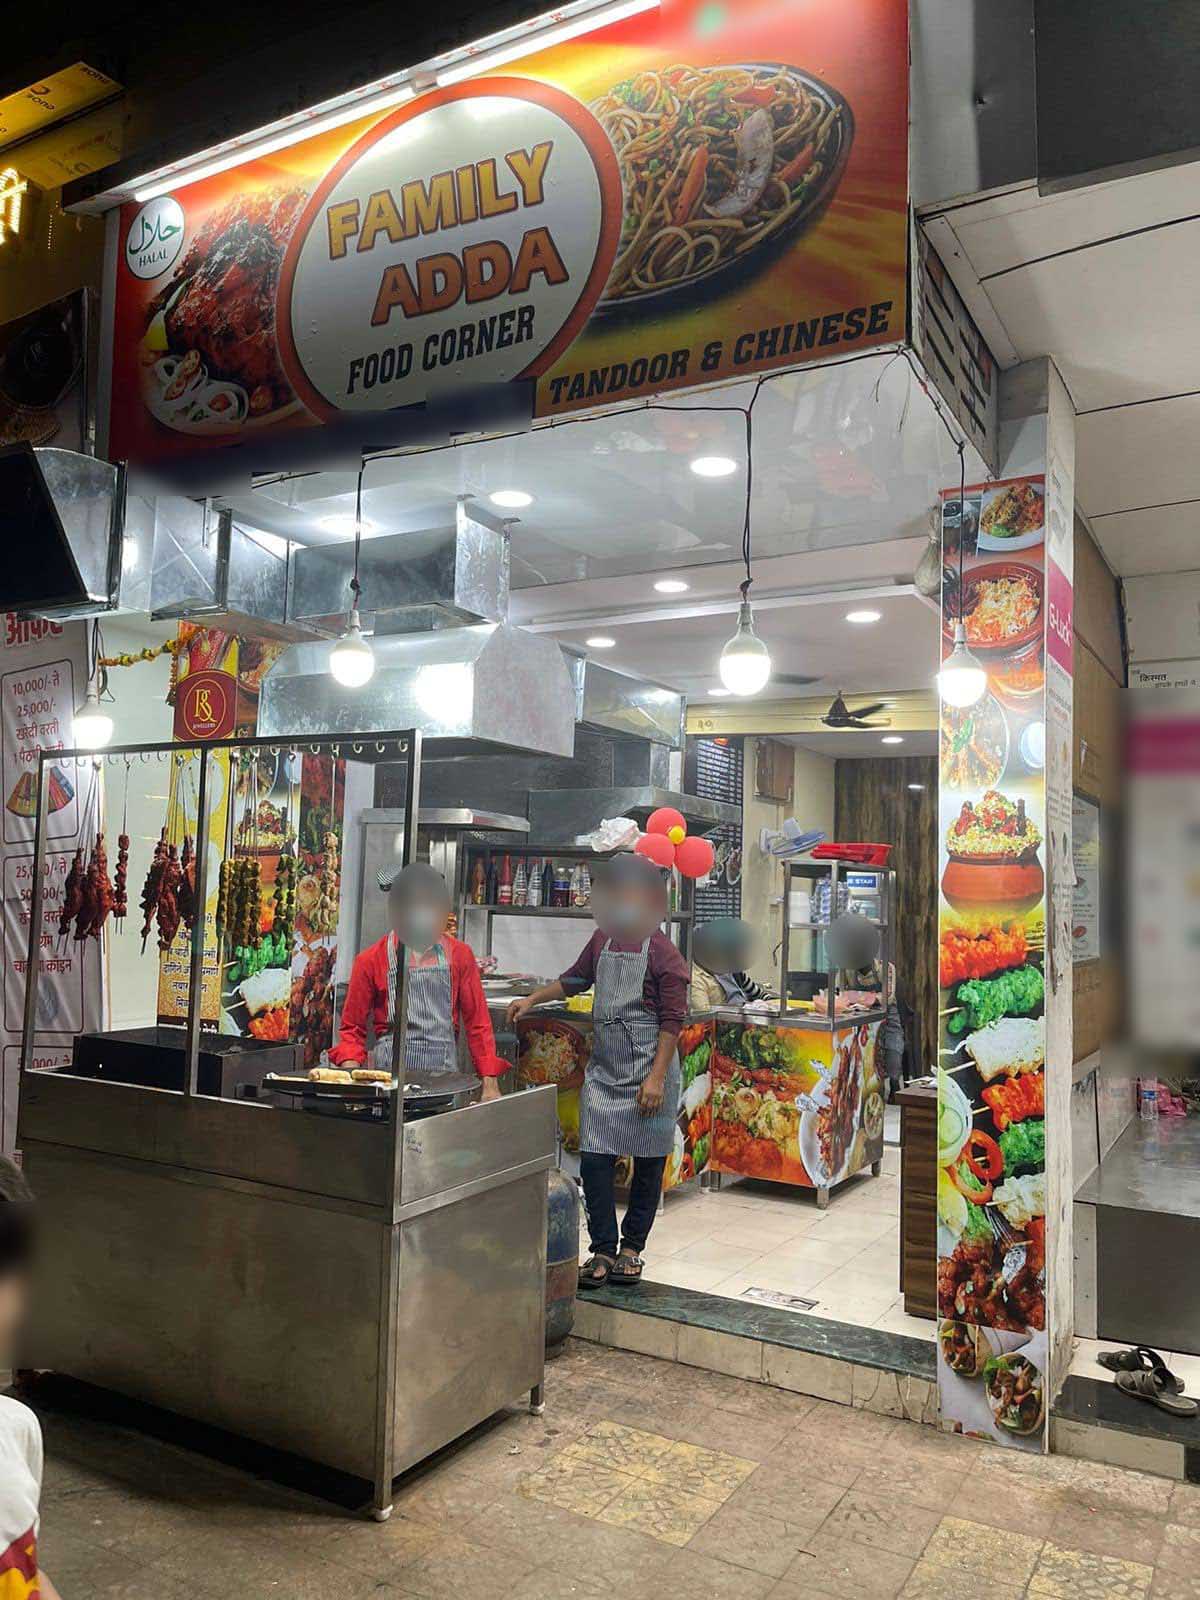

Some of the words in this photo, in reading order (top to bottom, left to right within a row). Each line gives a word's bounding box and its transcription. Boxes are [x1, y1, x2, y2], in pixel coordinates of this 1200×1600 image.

[129, 214, 181, 255] حلال
[327, 140, 554, 260] FAMILY
[139, 247, 168, 267] HALAL
[370, 226, 570, 327] ADDA
[346, 343, 414, 394] FOOD
[422, 304, 536, 371] CORNER
[549, 348, 690, 404] TANDOOR
[701, 340, 722, 372] &
[732, 300, 893, 365] CHINESE
[16, 697, 56, 718] 25,000/-
